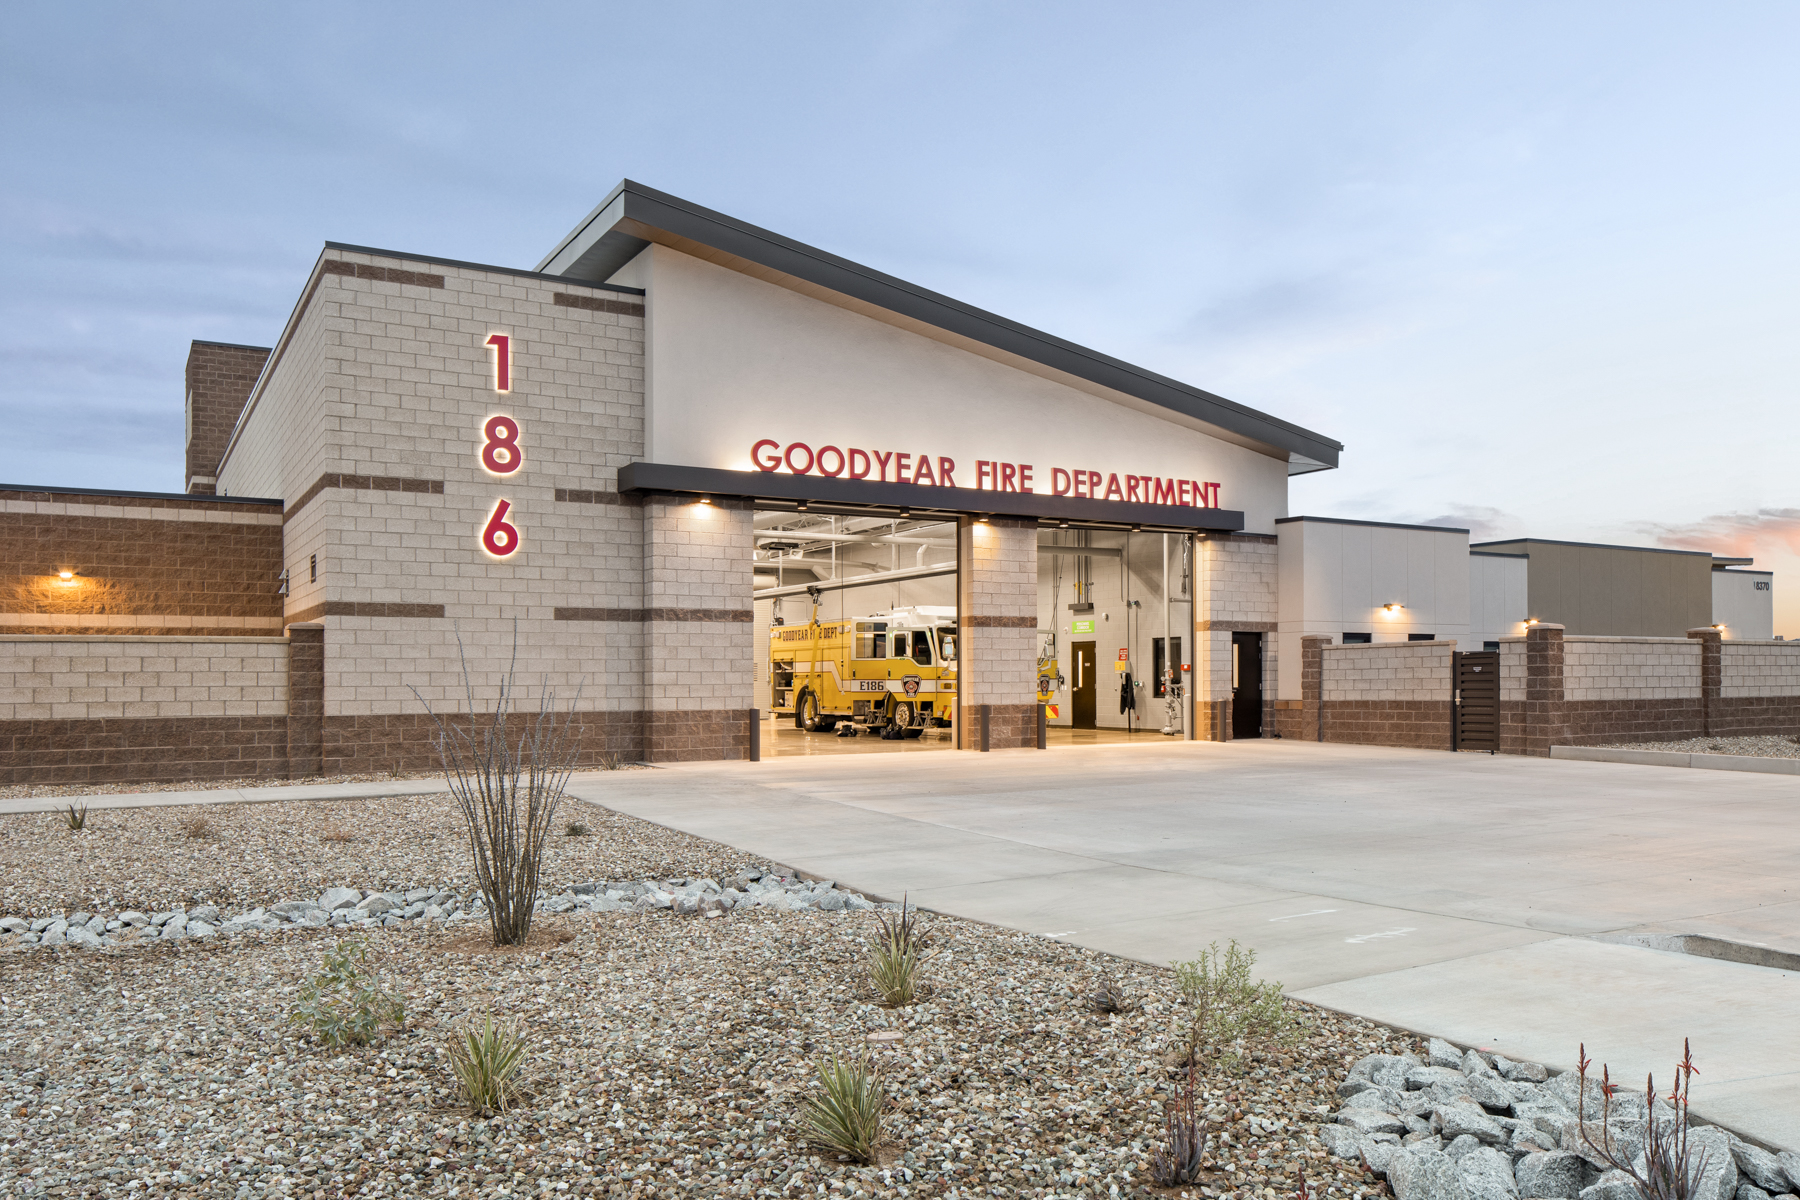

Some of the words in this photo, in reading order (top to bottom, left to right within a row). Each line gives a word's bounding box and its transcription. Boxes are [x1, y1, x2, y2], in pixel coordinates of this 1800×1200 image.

[481, 334, 522, 556] 186
[751, 439, 957, 487] GOODYEAR
[975, 460, 1034, 493] FIRE
[1051, 467, 1221, 509] DEPARTMENT
[1753, 581, 1770, 591] 18370
[824, 626, 837, 639] DEPT
[860, 681, 884, 691] E186
